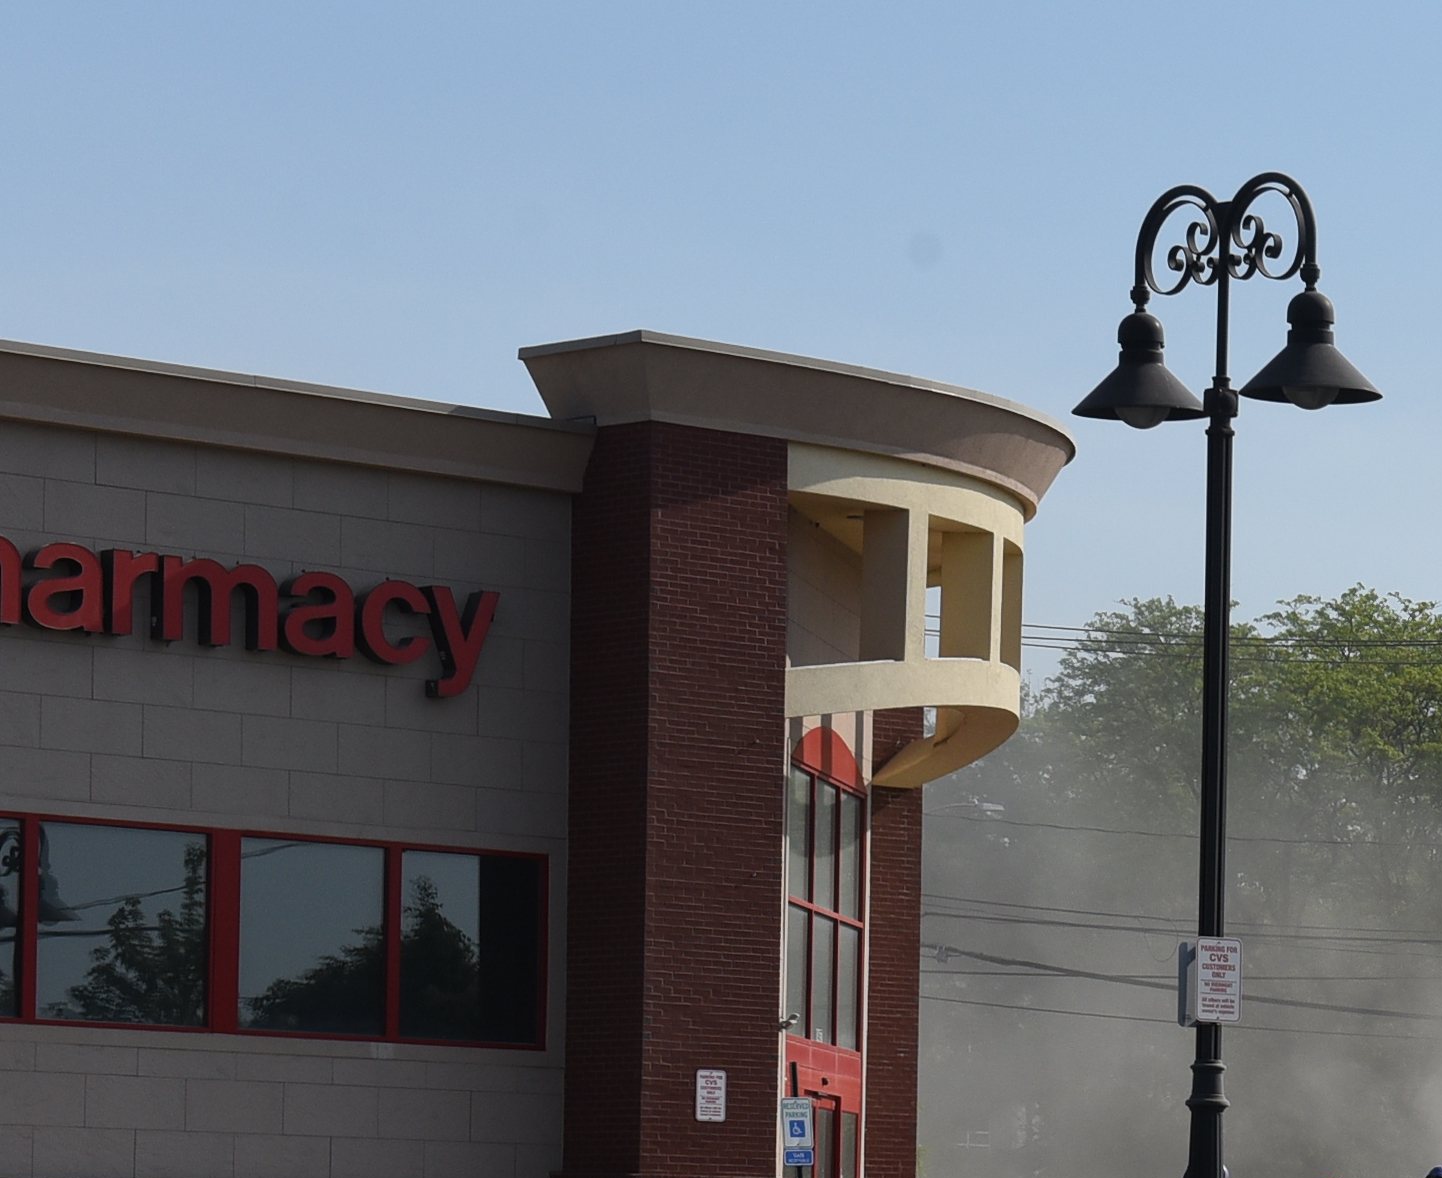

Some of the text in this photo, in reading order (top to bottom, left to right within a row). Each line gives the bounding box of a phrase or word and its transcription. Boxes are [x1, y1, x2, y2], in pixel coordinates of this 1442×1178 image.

[1201, 944, 1225, 953] PARKING
[1209, 953, 1229, 962] CVS
[1202, 963, 1236, 972] CUSTOMERS
